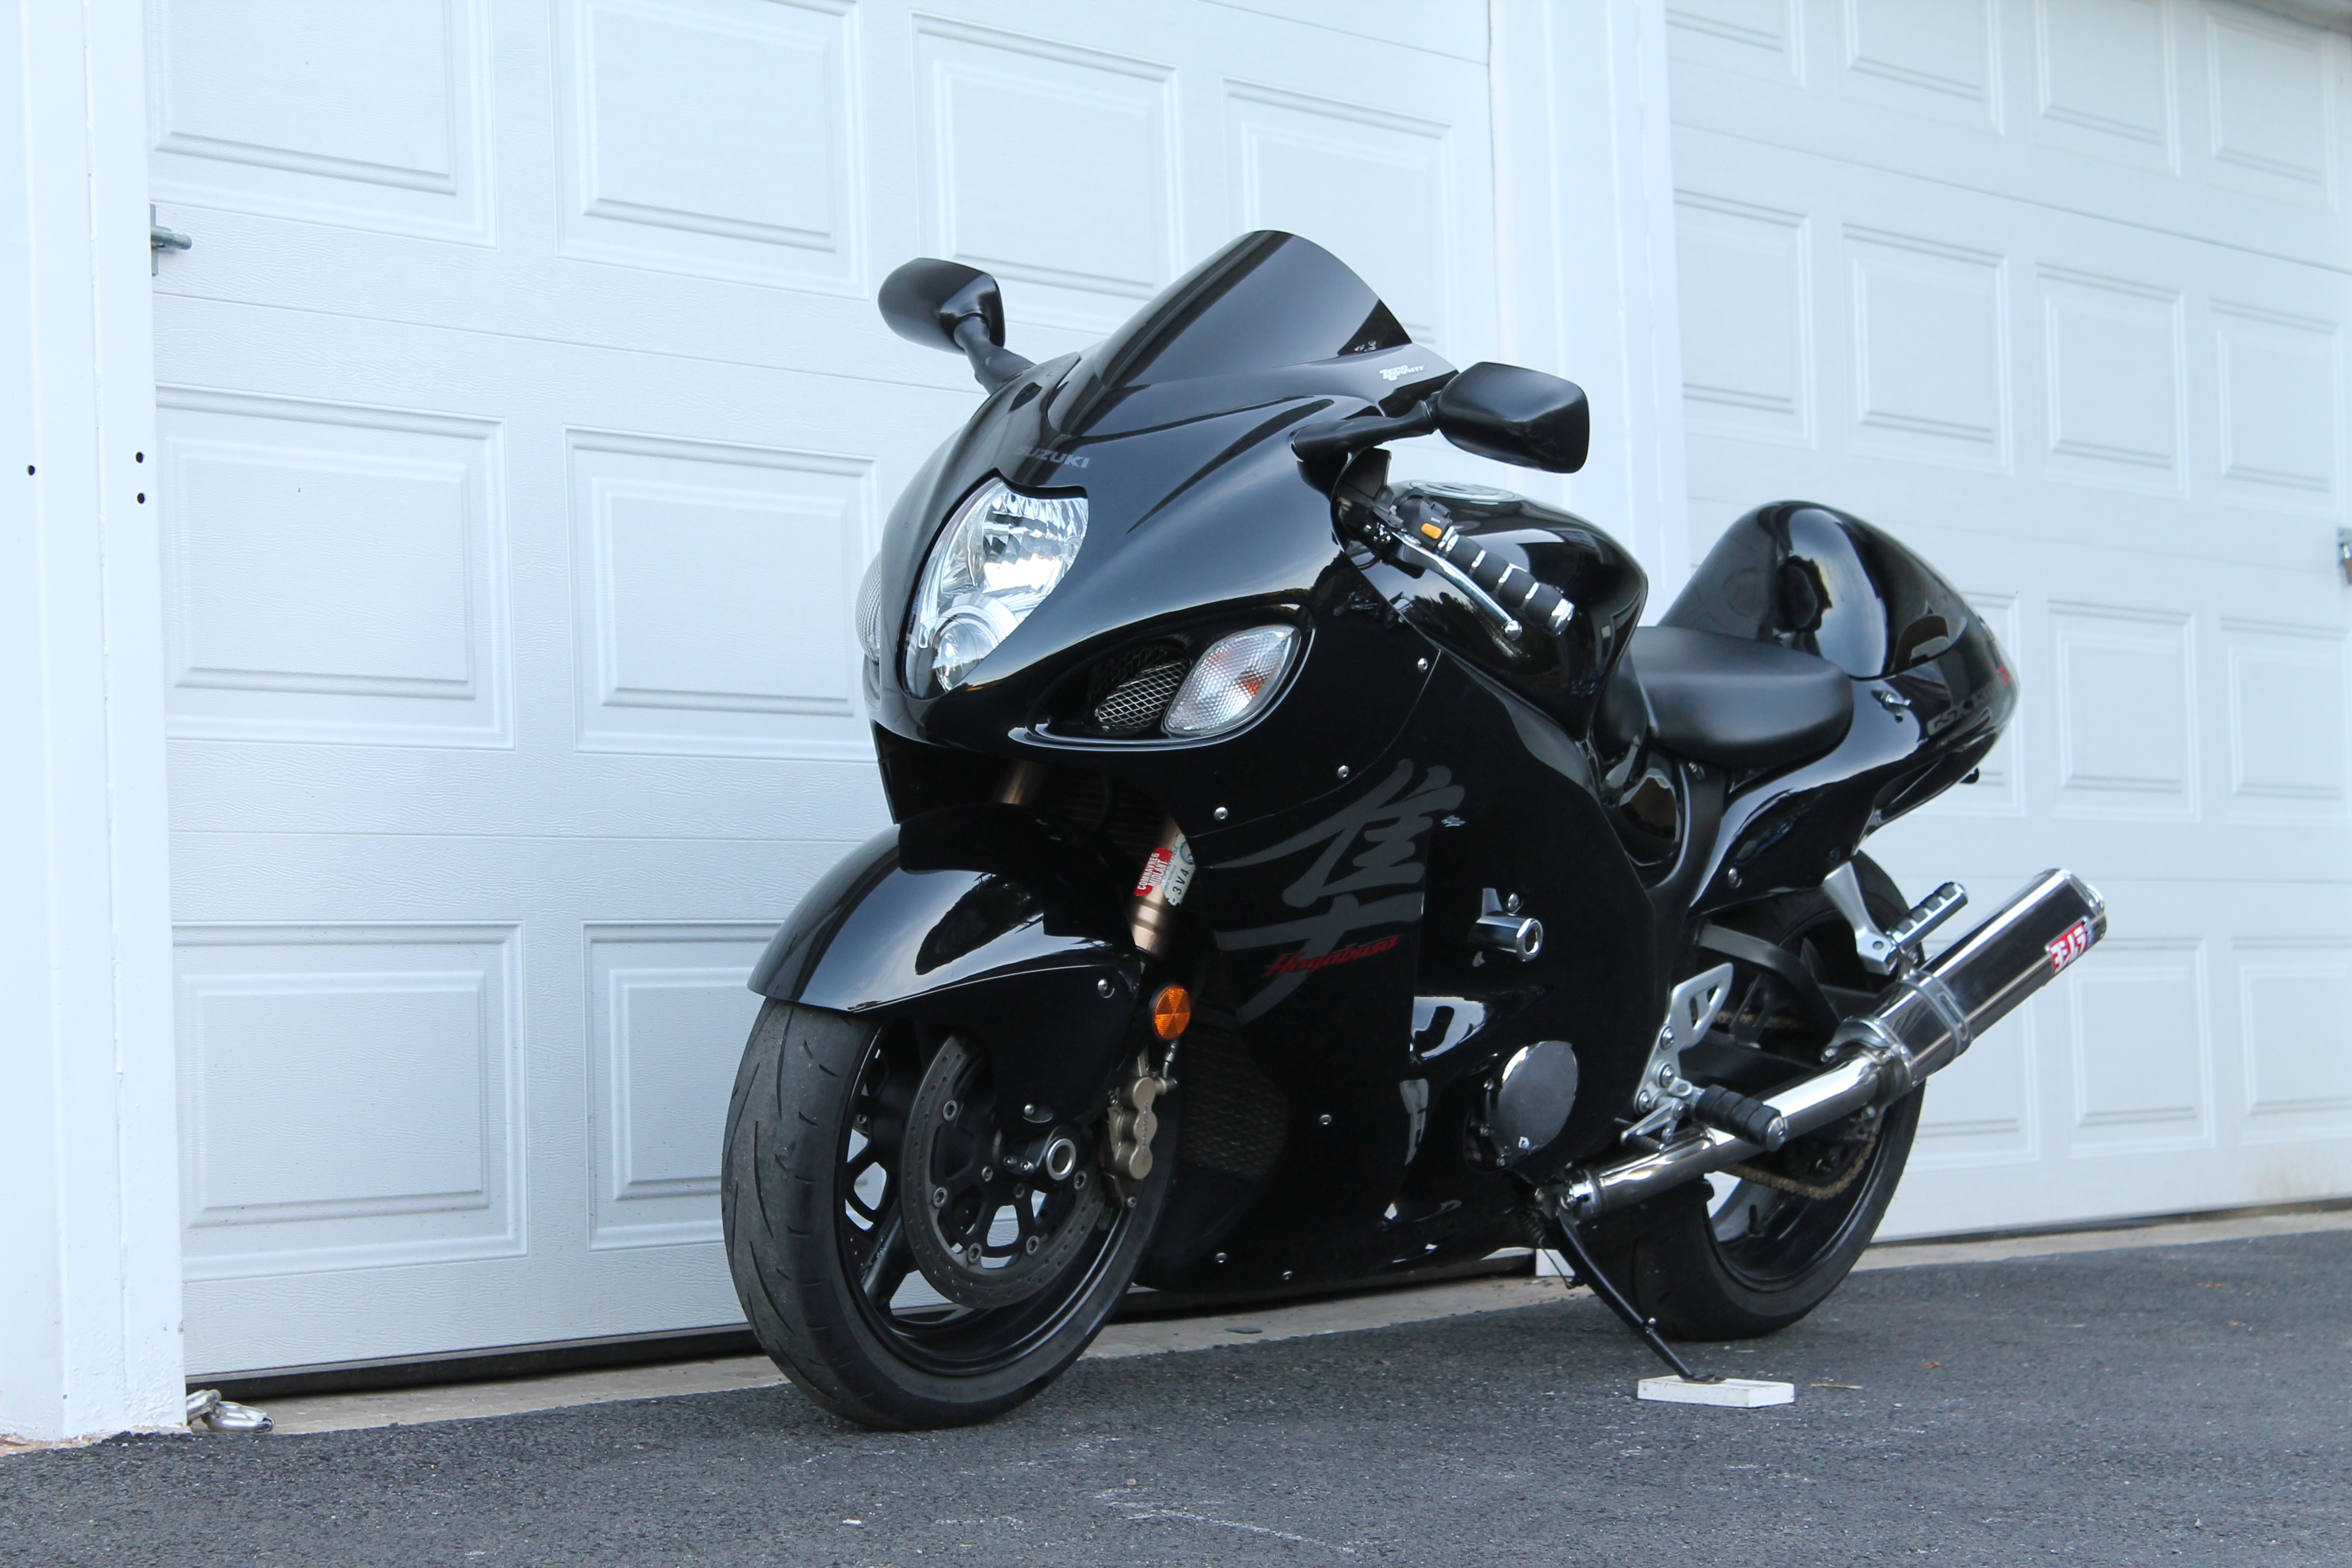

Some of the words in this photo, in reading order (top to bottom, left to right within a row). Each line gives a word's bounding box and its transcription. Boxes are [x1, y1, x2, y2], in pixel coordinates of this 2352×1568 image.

[1379, 364, 1408, 379] ZERO
[1388, 365, 1424, 381] GRAVITY
[1014, 445, 1091, 469] SUZUKI
[1137, 853, 1160, 890] COMNAVREG
[1147, 859, 1168, 887] MIDLANT
[1264, 935, 1400, 978] Hayabusa
